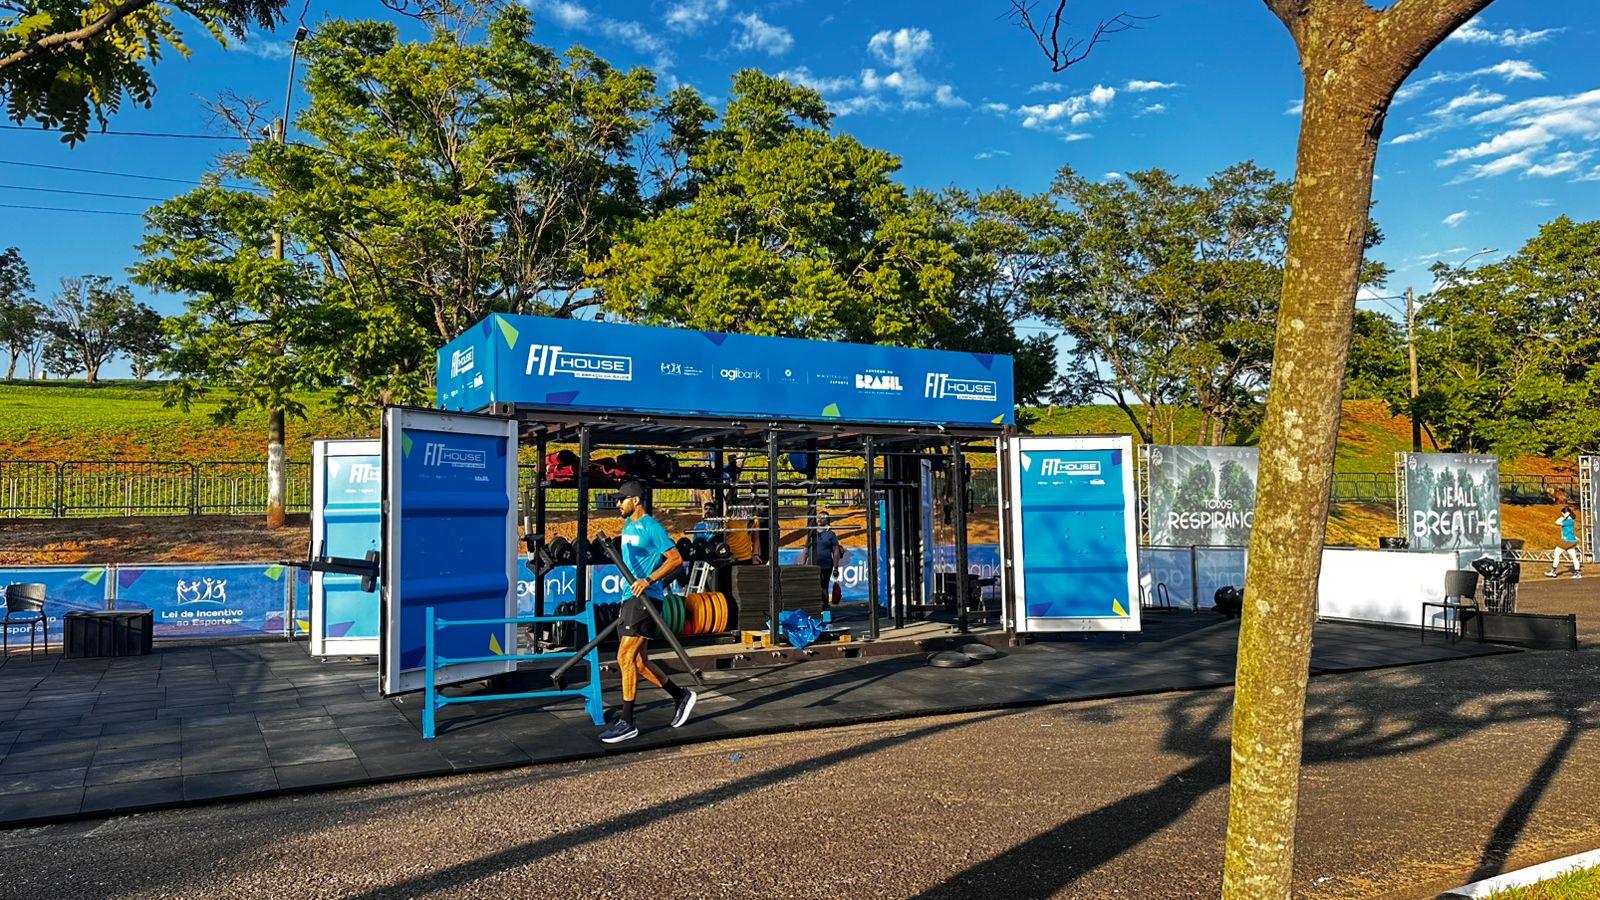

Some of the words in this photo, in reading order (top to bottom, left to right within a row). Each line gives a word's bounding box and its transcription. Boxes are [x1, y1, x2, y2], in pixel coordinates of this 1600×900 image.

[525, 344, 563, 376] FIT
[560, 357, 626, 372] HOUSE
[720, 368, 761, 381] agibank
[855, 374, 904, 391] BRASIL
[924, 372, 949, 399] FIT
[947, 383, 992, 394] HOUSE
[423, 442, 446, 467] FIT
[443, 452, 482, 462] HOUSE
[1041, 458, 1061, 476] FIT
[1059, 463, 1097, 471] HOUSE
[1205, 499, 1233, 509] TODOS
[1436, 486, 1454, 508] WE
[1457, 486, 1477, 508] ALL
[1413, 508, 1498, 538] BREATHE
[161, 611, 178, 619] Lei
[196, 609, 244, 617] Incentivo
